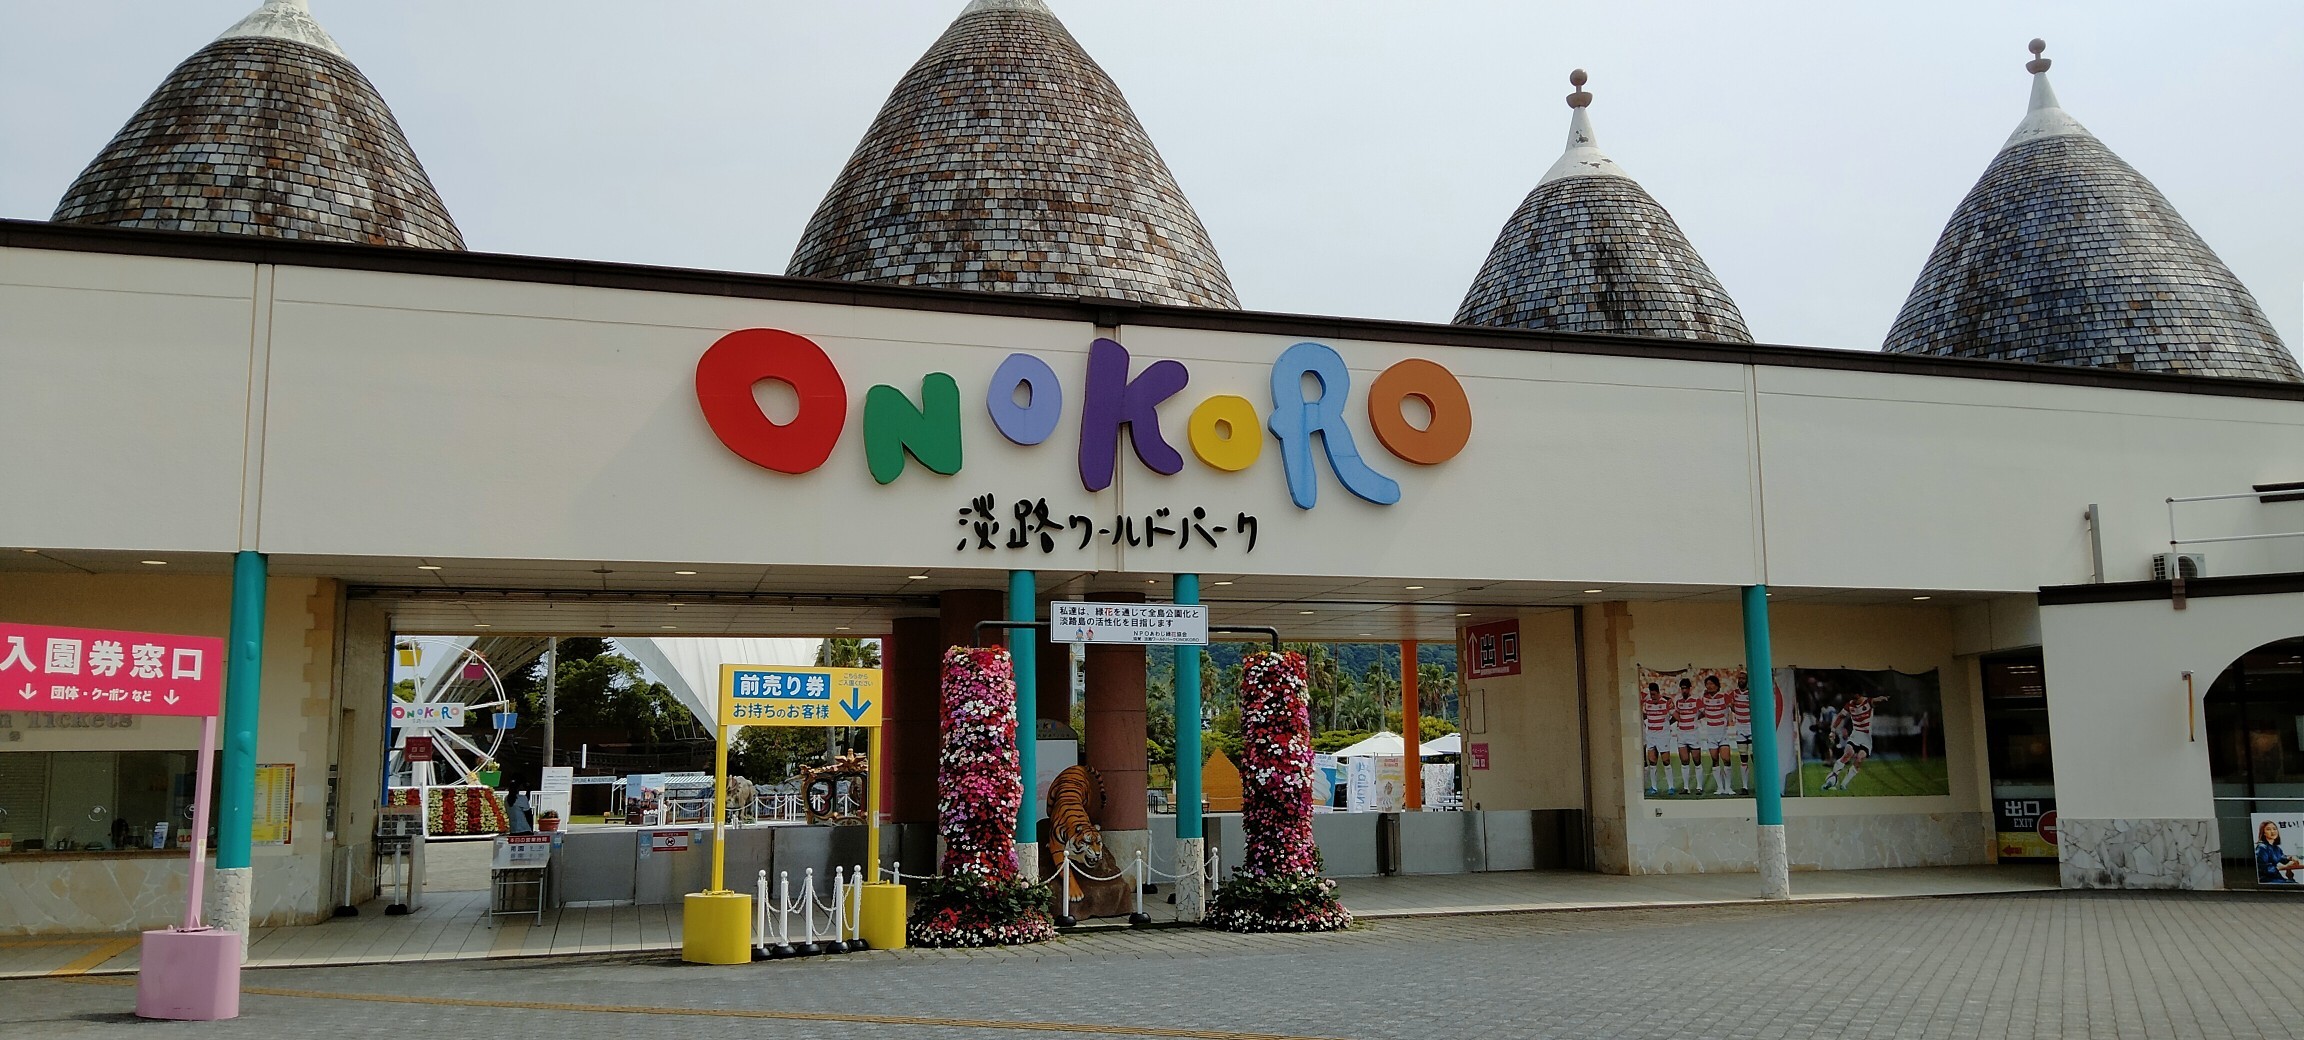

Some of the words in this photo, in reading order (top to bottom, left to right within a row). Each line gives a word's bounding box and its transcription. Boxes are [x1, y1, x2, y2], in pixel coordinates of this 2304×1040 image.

[695, 327, 1473, 511] ONOKORO
[956, 492, 1258, 554] 淡路ワールドパーク
[1059, 616, 1174, 628] 淡路島の活性化を目指します
[0, 635, 204, 681] 入園券窓口
[1480, 631, 1519, 668] 出口
[51, 685, 129, 702] 団体・クーポン
[132, 689, 152, 702] など
[740, 674, 825, 697] 前売り券
[392, 706, 460, 719] ONOKORO
[733, 703, 830, 719] お持ちのお客様
[2005, 801, 2041, 817] 出口
[2013, 818, 2034, 828] EXIT
